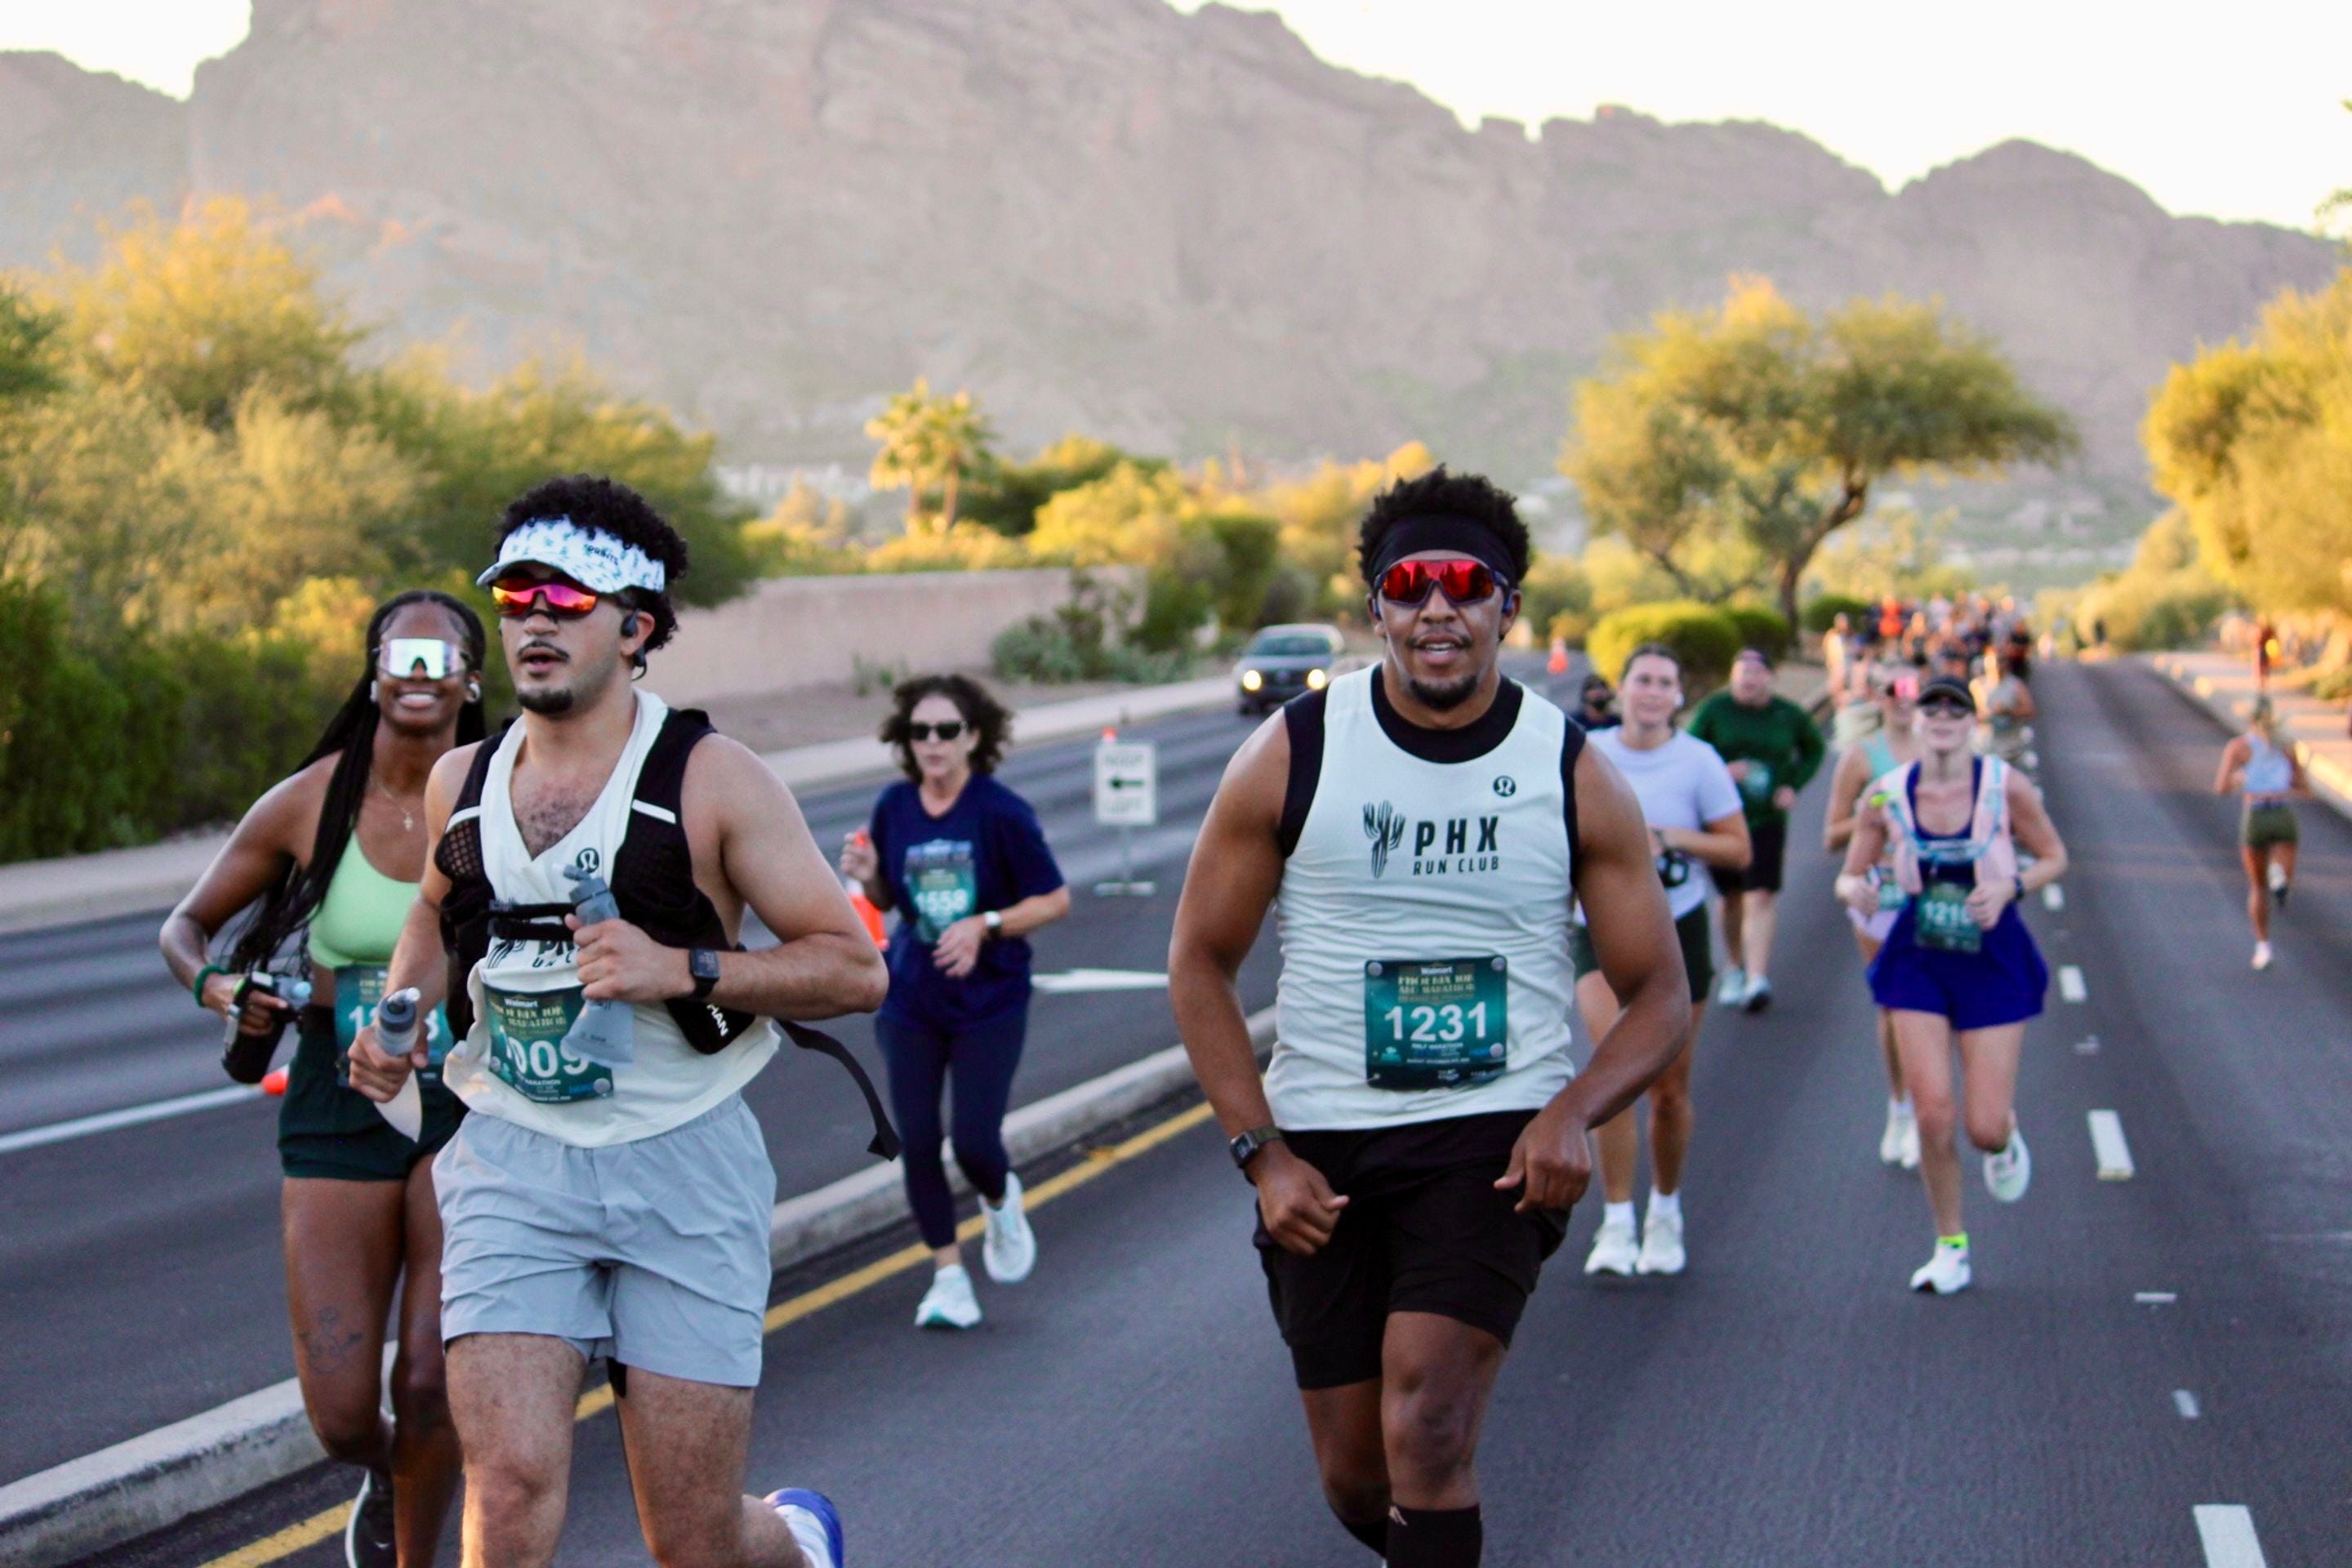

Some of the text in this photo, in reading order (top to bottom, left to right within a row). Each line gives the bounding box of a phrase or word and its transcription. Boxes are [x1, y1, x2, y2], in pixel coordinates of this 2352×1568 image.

[1414, 815, 1499, 857] PHX
[1413, 855, 1499, 875] RUN CLUB
[1420, 966, 1454, 975] Walmart
[504, 998, 538, 1008] Walmart
[1384, 1001, 1487, 1042] 1231
